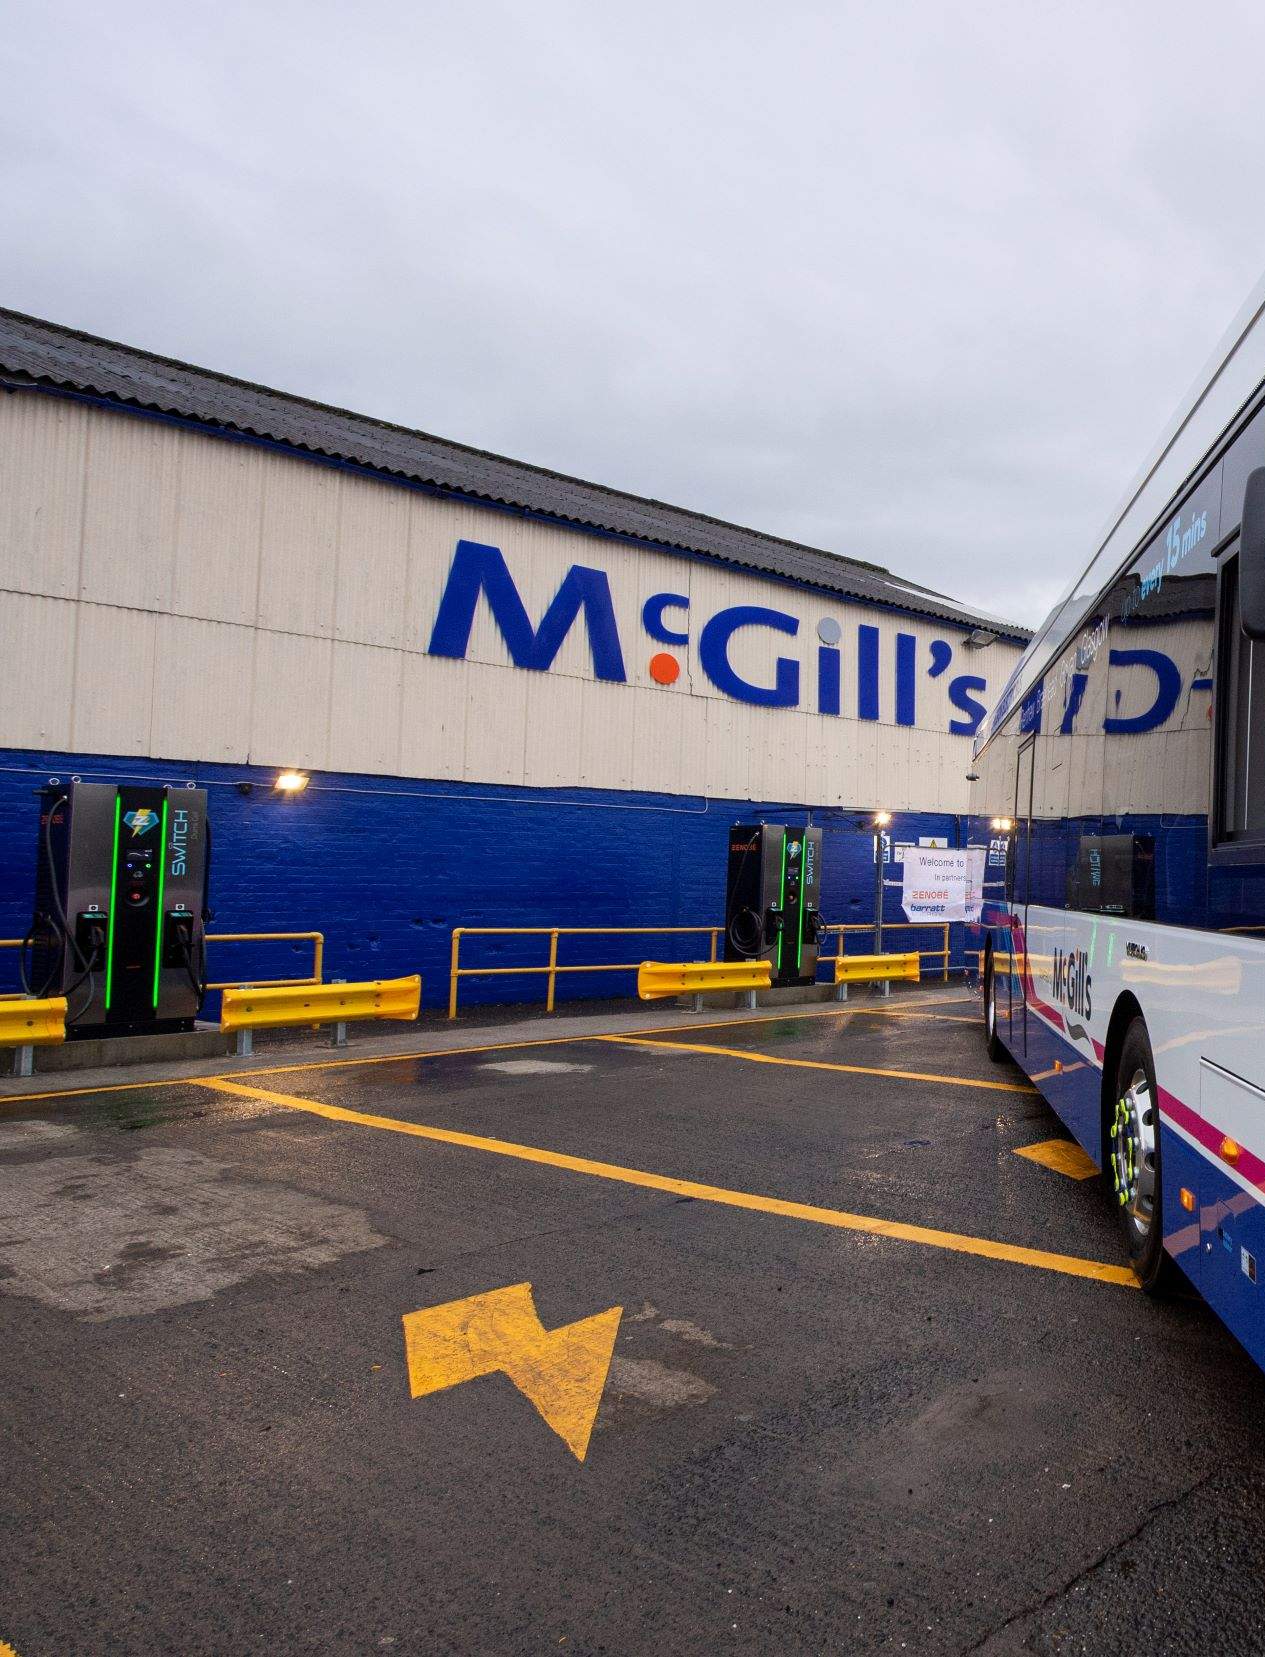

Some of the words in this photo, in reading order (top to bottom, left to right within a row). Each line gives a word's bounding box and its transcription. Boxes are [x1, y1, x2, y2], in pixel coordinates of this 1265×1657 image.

[1140, 559, 1164, 600] every
[1166, 516, 1181, 574] 15
[1181, 510, 1207, 558] mins
[427, 538, 988, 738] McGill's
[172, 809, 189, 876] SWITCH
[806, 841, 815, 886] SWITCH
[919, 856, 954, 868] Welcome
[956, 859, 965, 868] to
[910, 903, 946, 913] barratt
[1052, 945, 1092, 1022] McGill's
